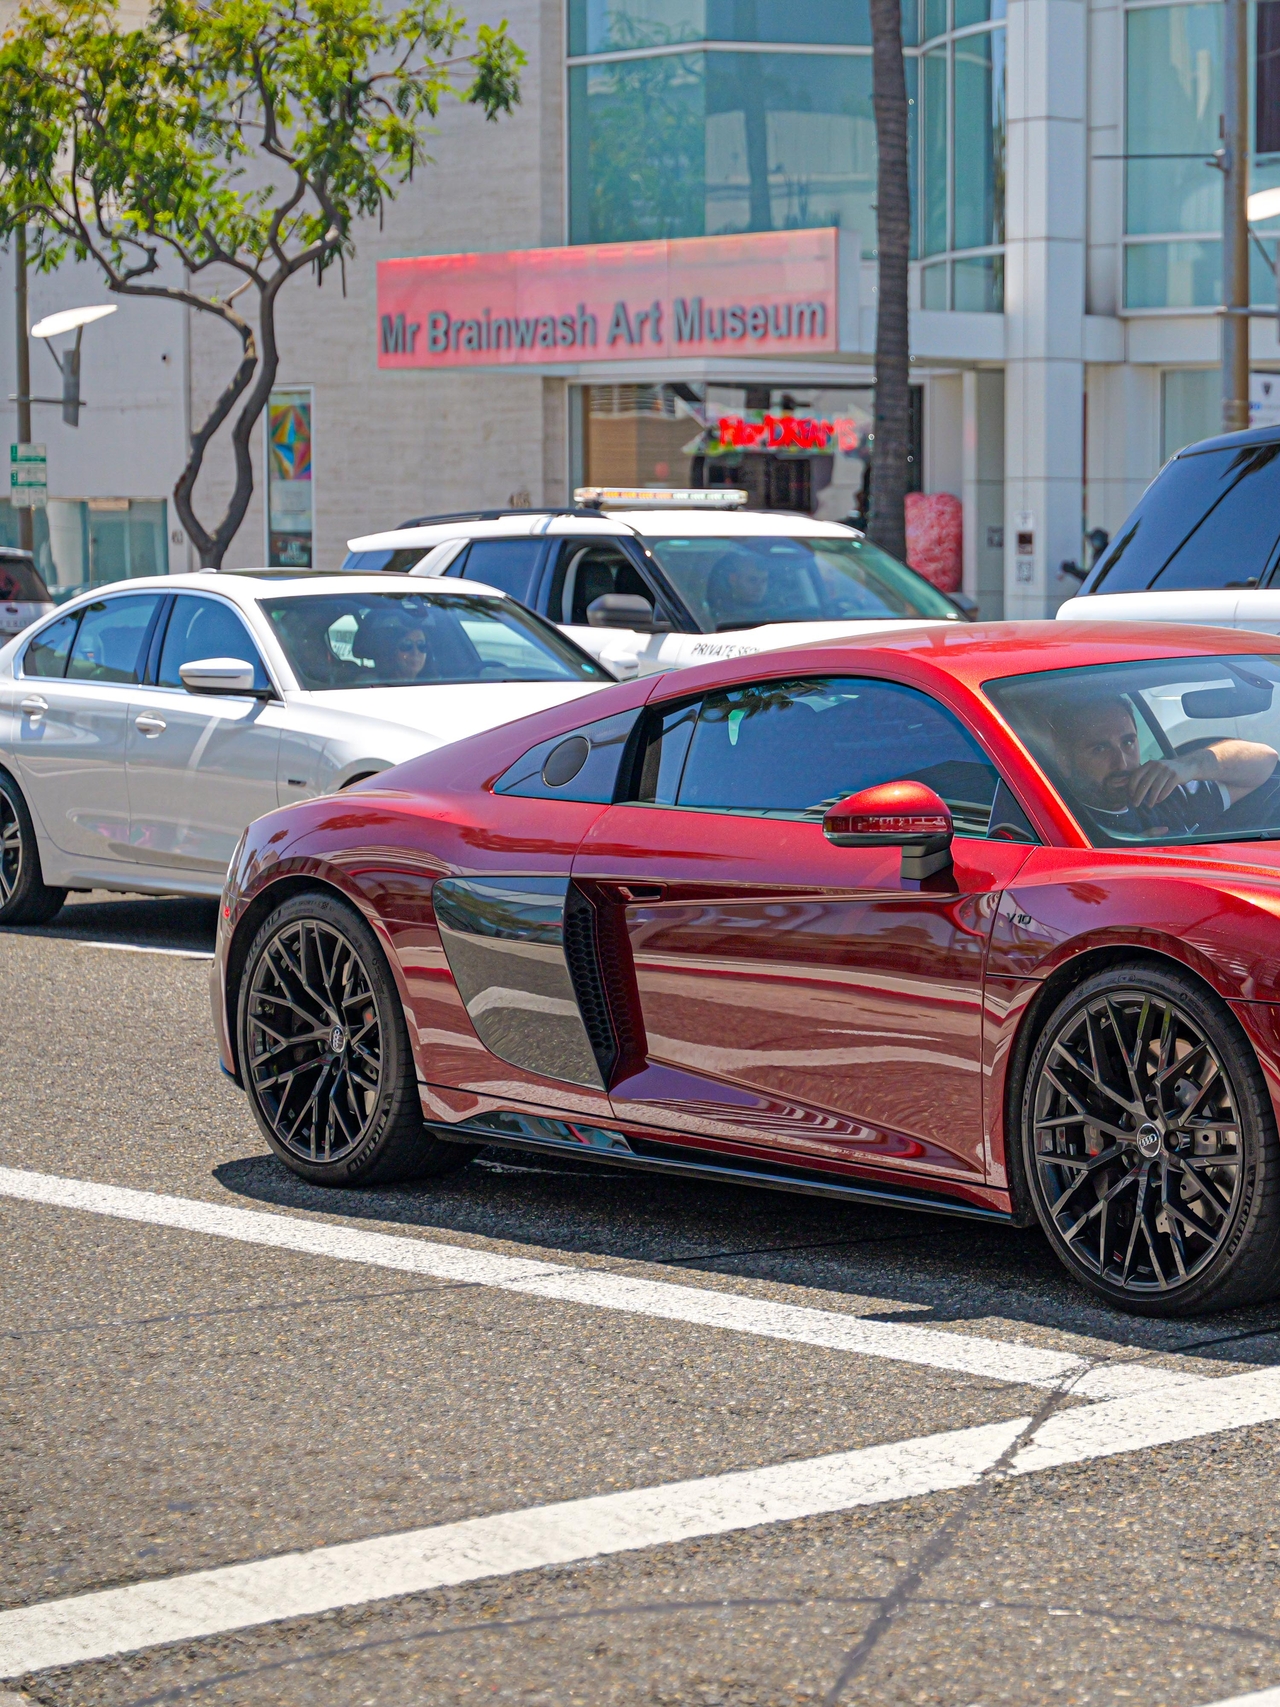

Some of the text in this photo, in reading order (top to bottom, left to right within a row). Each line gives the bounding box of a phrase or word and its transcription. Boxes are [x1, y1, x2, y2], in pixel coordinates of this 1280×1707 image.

[380, 297, 826, 353] Mr Brainwash Art Museum
[691, 643, 737, 656] PRIVATE
[1007, 912, 1032, 925] V10
[1229, 1185, 1254, 1254] MICHELIN
